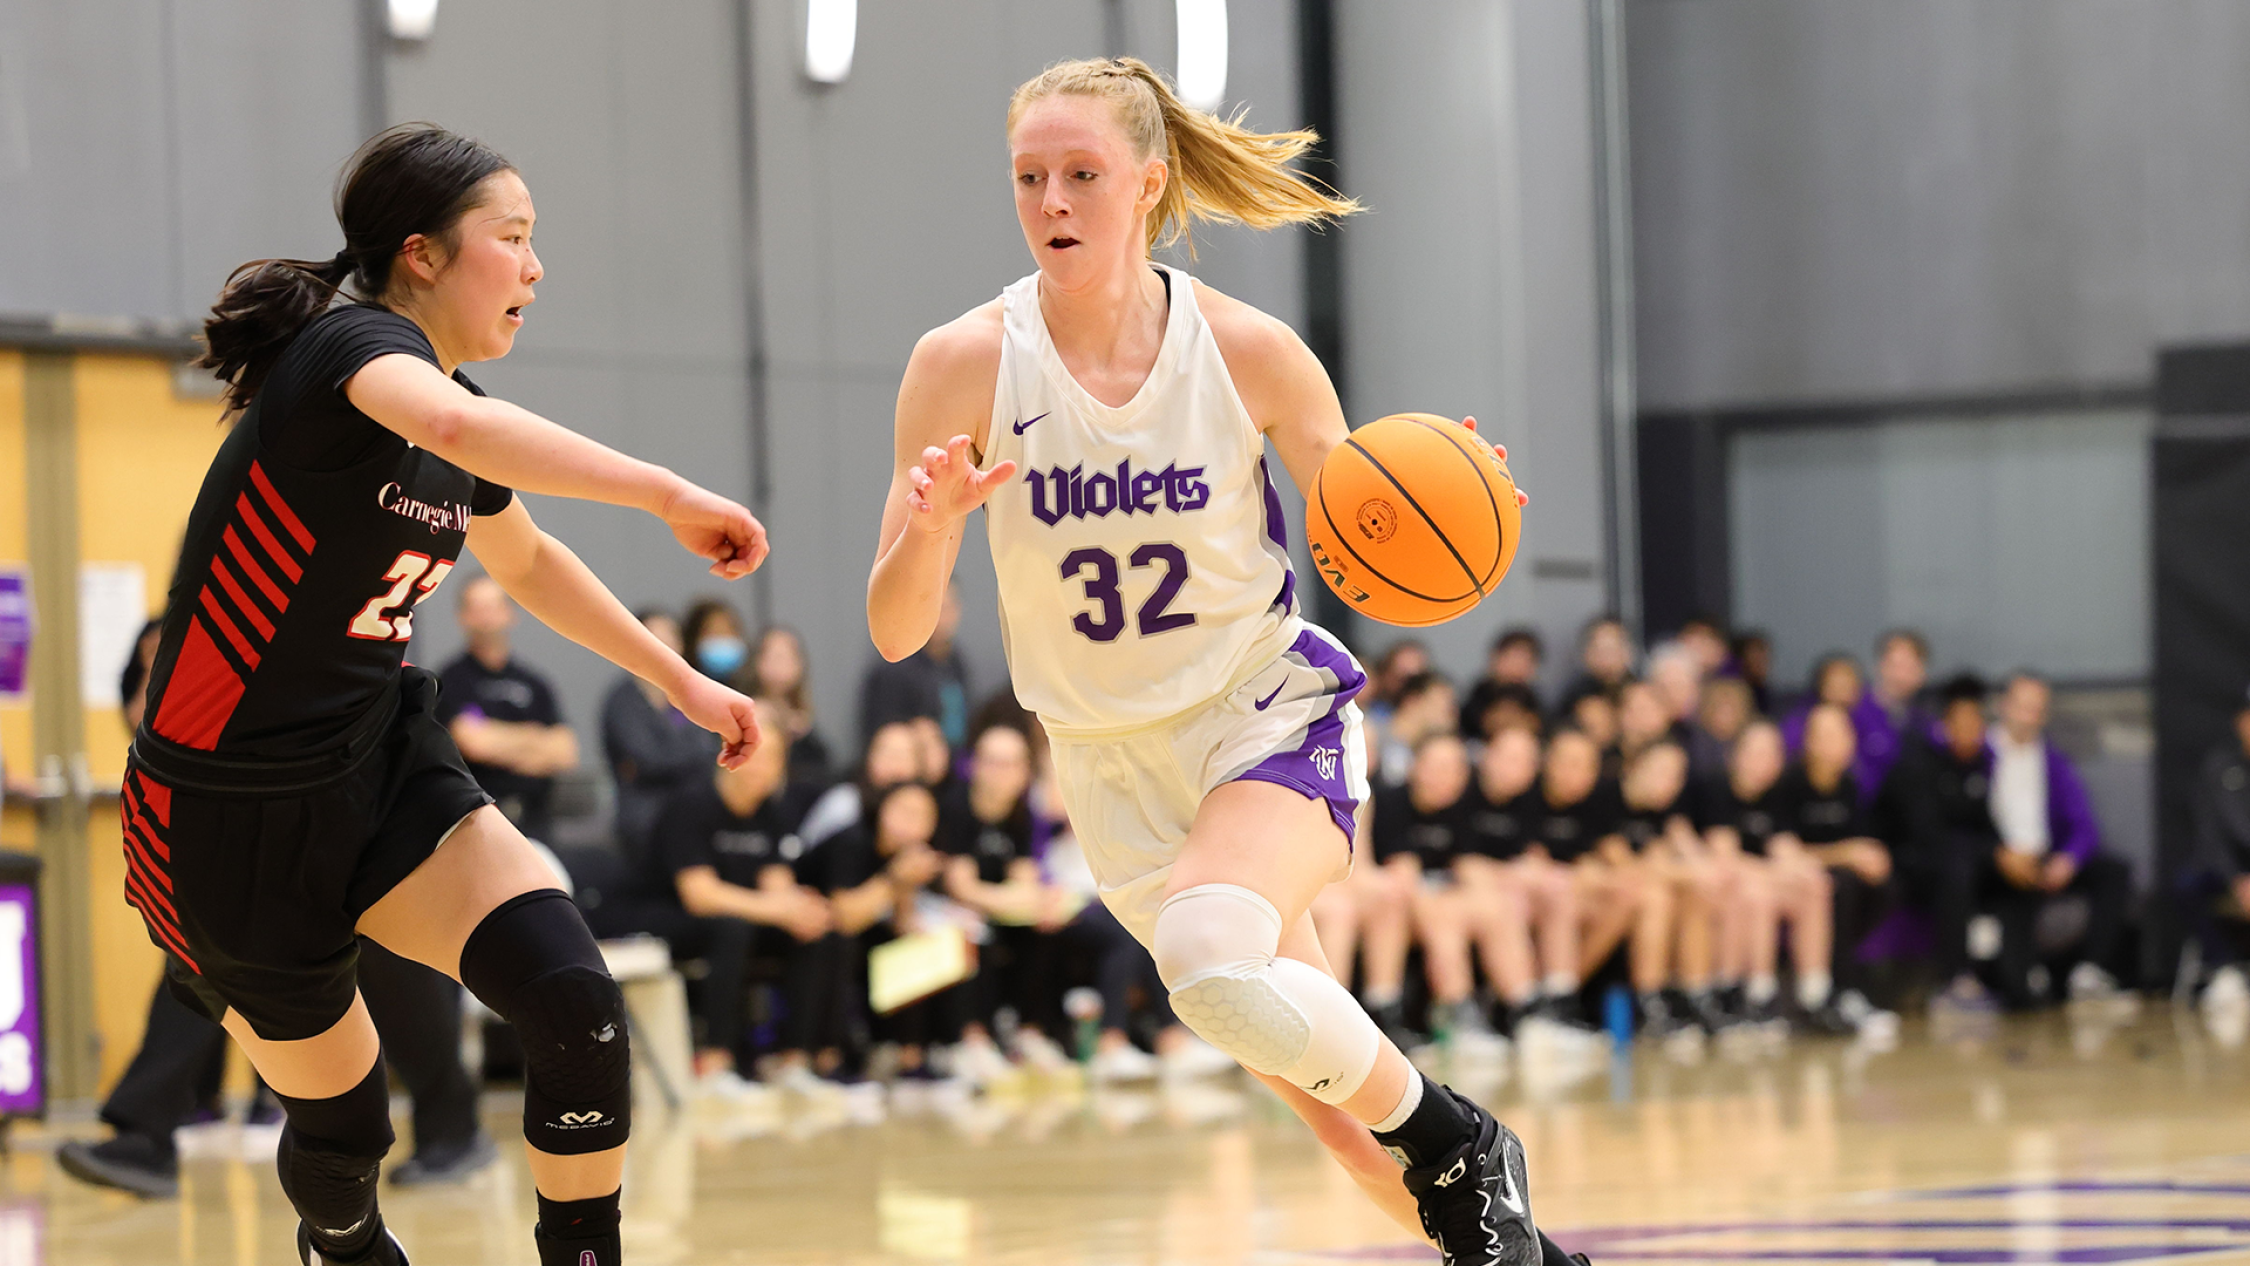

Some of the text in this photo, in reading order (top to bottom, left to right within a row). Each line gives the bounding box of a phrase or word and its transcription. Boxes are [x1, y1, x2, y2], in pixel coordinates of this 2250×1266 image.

[377, 481, 472, 535] Carnegie M
[1022, 454, 1212, 529] Violets
[1057, 540, 1199, 645] 32
[1311, 541, 1371, 603] EVO
